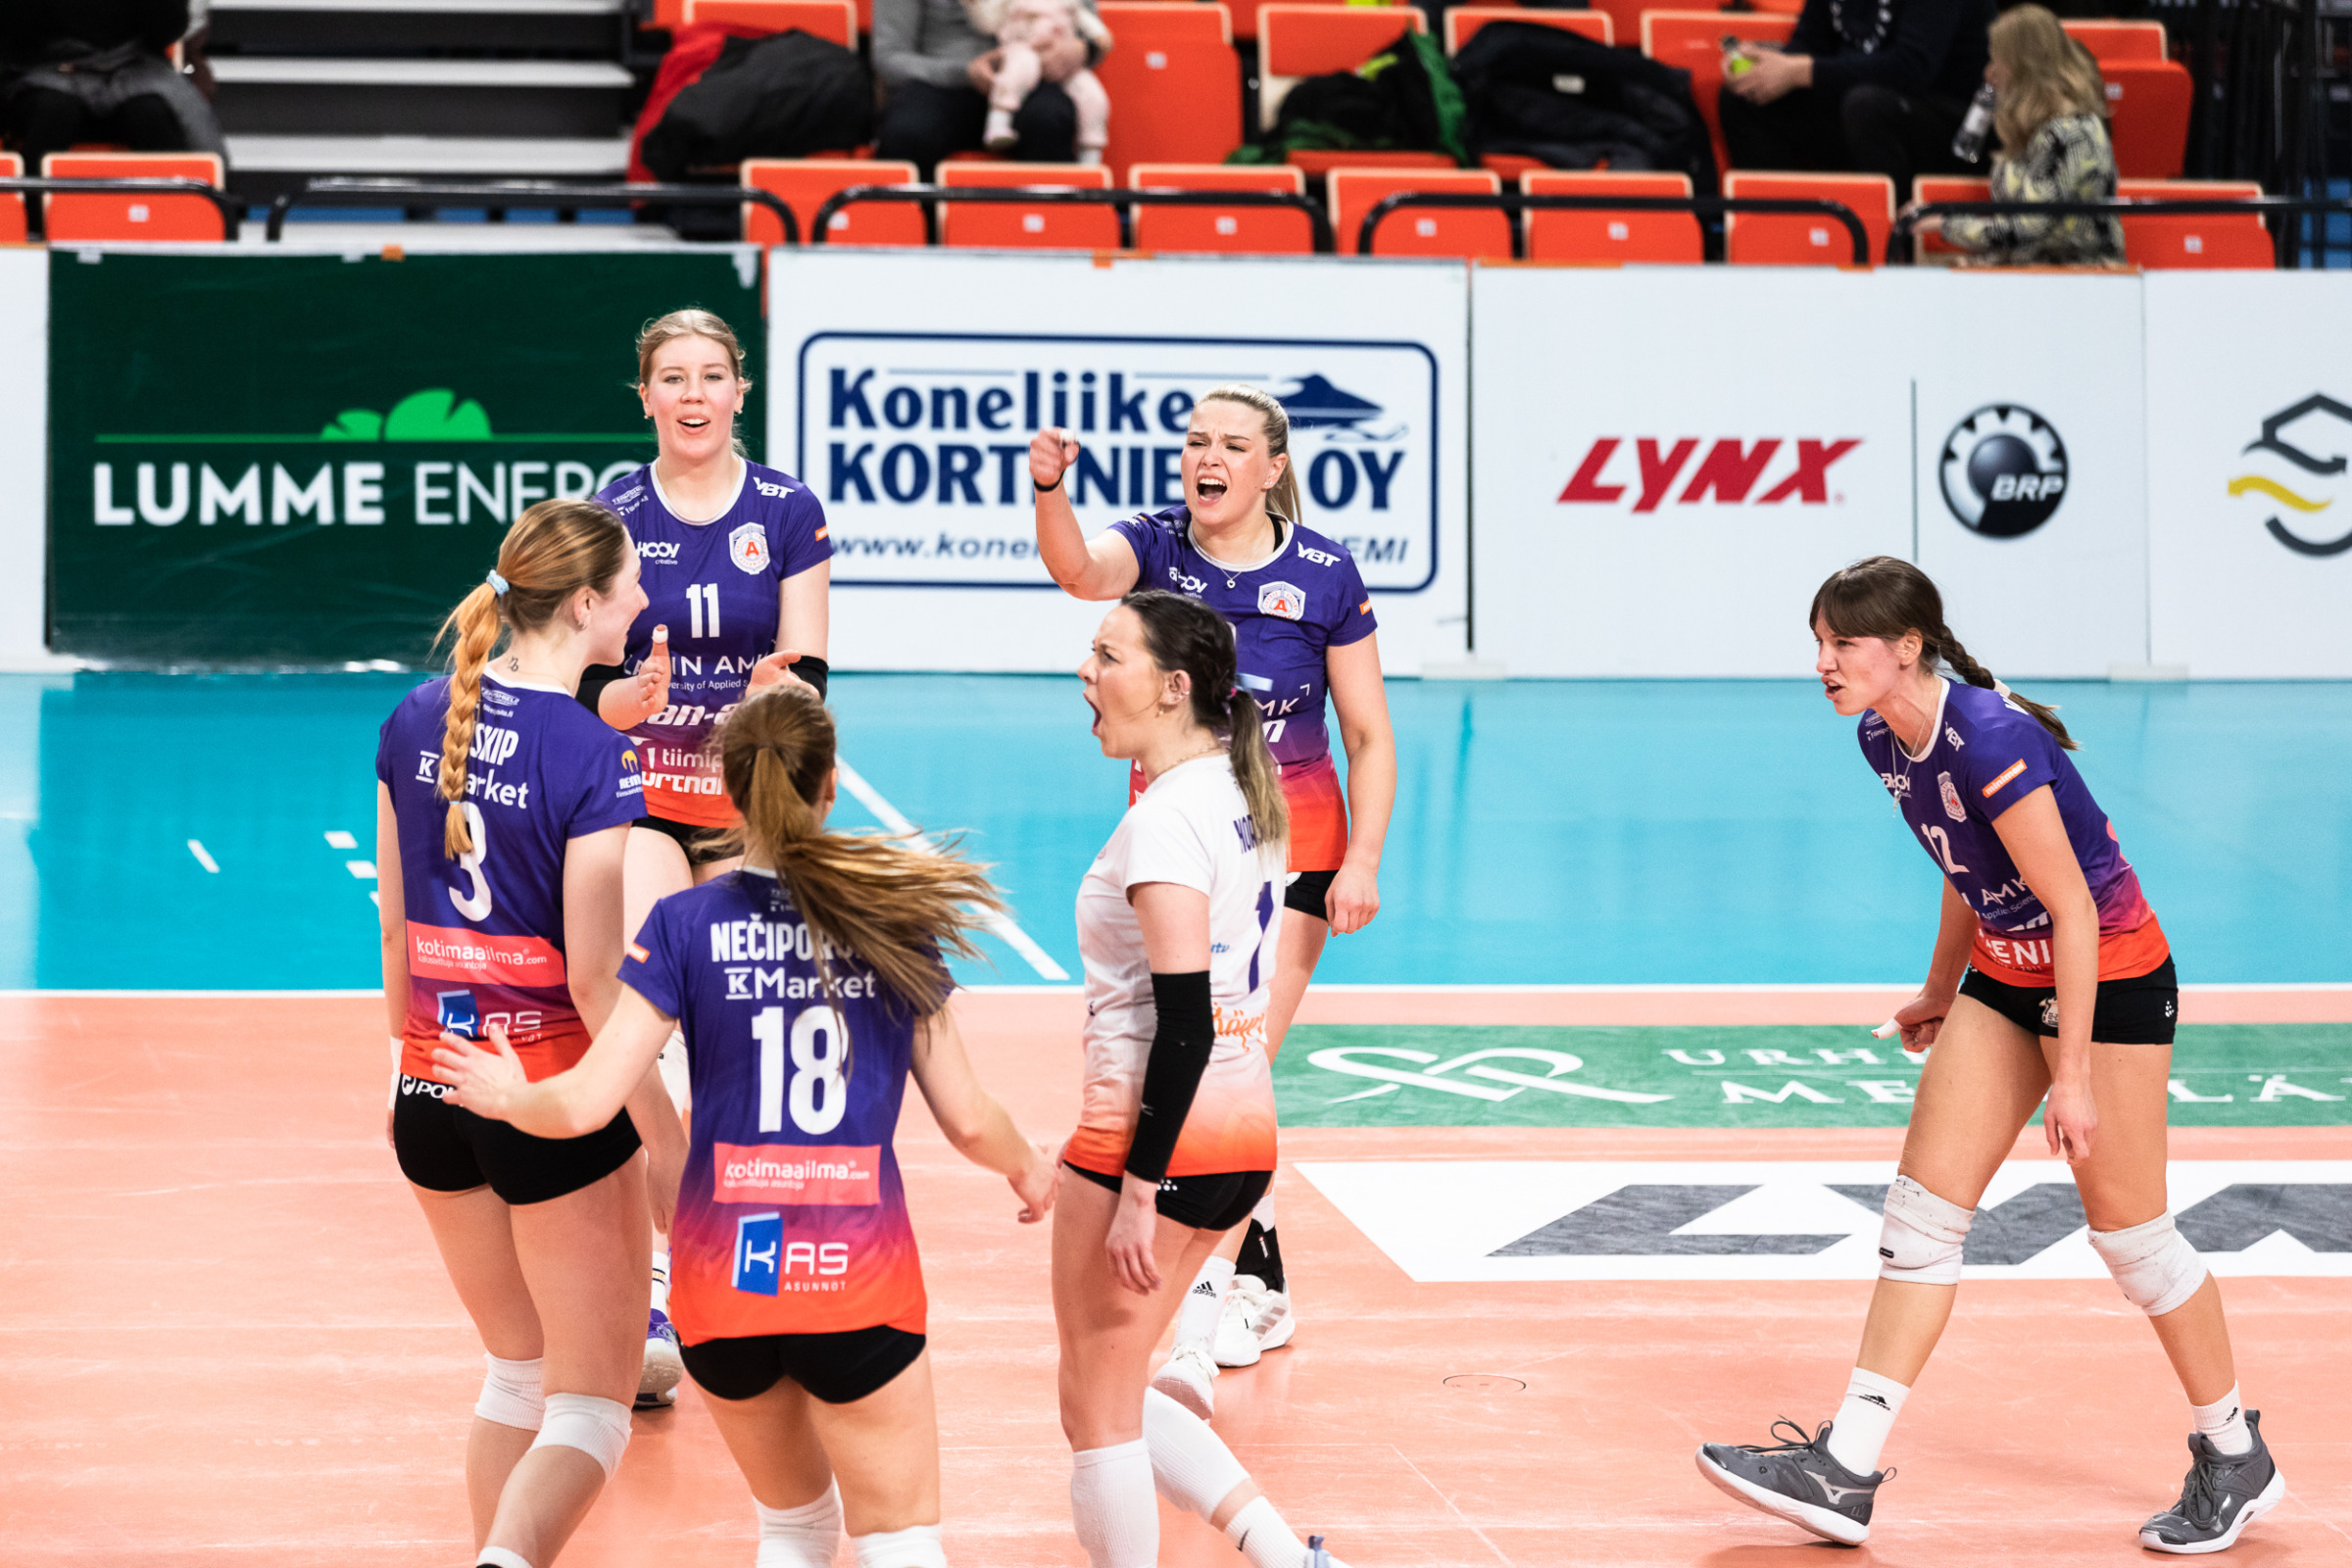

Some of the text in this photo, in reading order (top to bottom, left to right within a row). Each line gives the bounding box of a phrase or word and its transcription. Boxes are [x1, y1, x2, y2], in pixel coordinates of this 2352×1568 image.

[829, 367, 1195, 432] Koneliike
[94, 462, 385, 525] LUMME
[753, 476, 796, 500] YBT
[1308, 449, 1404, 512] OY
[1558, 437, 1863, 512] LYNX
[1990, 472, 2065, 502] BRP
[1297, 541, 1342, 567] YBT
[686, 583, 720, 638] 11
[696, 680, 706, 689] of
[709, 679, 742, 691] Applied
[465, 768, 529, 808] arket
[448, 801, 493, 922] 3
[751, 1004, 850, 1136] 18
[743, 1239, 850, 1276] KAS
[784, 1281, 847, 1293] ASUNNOT
